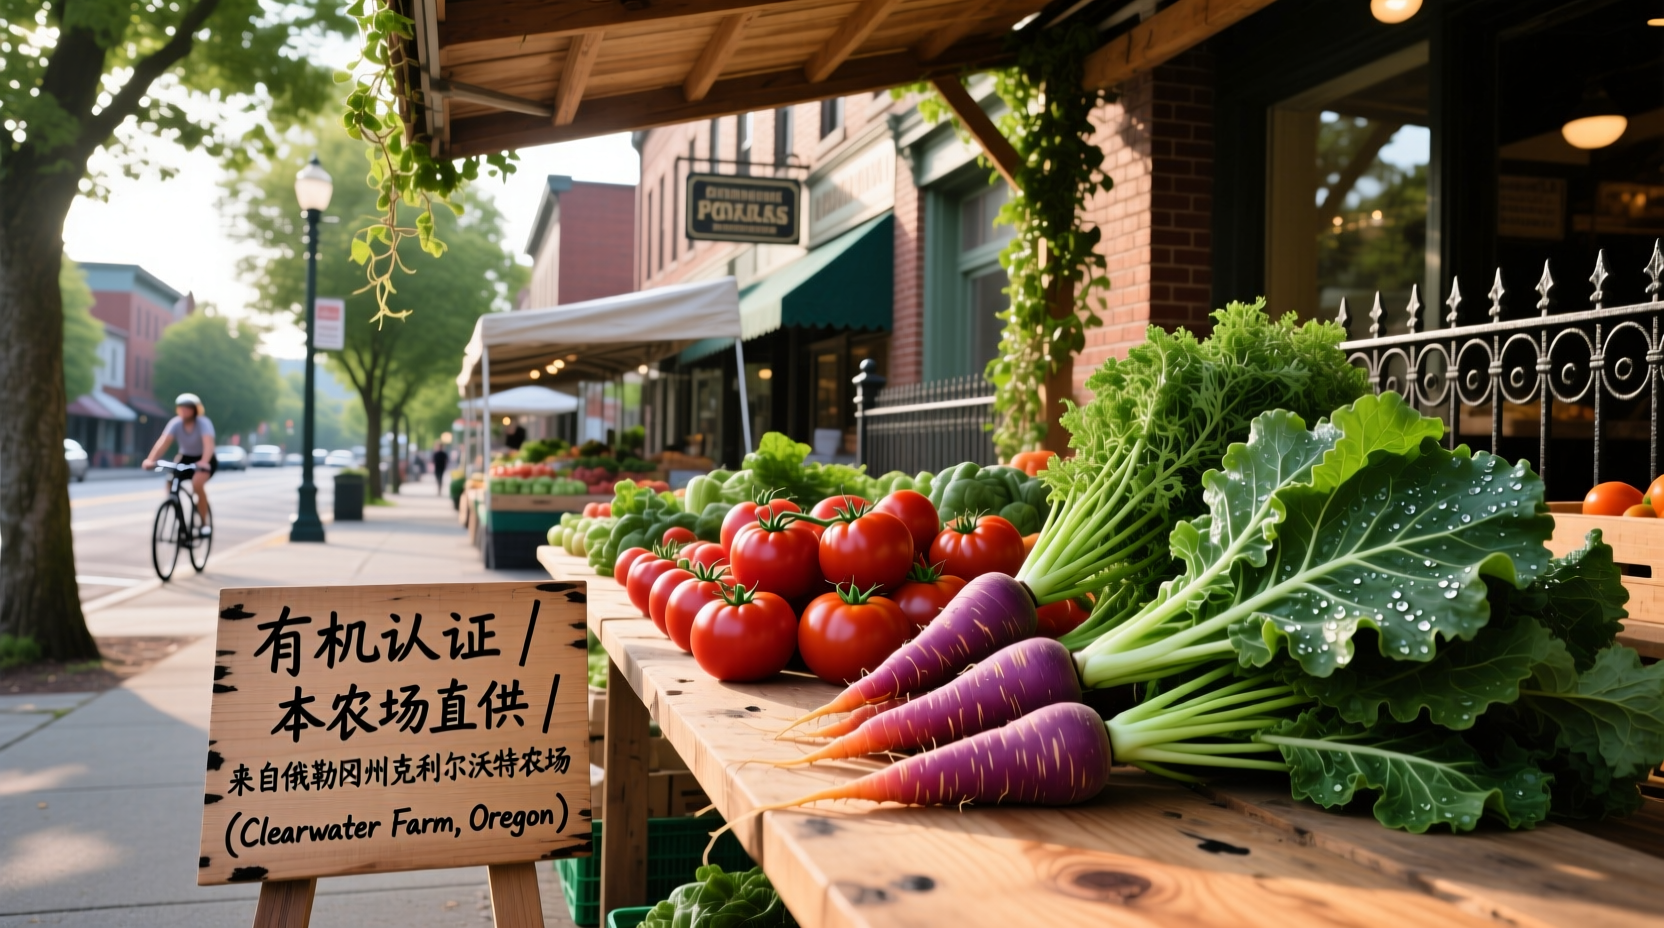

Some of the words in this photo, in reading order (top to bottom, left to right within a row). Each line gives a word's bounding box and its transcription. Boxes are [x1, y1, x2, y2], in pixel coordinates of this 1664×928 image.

[254, 605, 501, 677] 有机认证
[518, 599, 541, 667] /
[271, 678, 529, 743] 本农场直供
[541, 673, 561, 734] /
[227, 746, 571, 797] 来自俄勒冈州克利尔沃特农场
[225, 811, 381, 858] (Clearwater
[391, 807, 462, 838] Farm,
[469, 792, 569, 837] Oregon)
